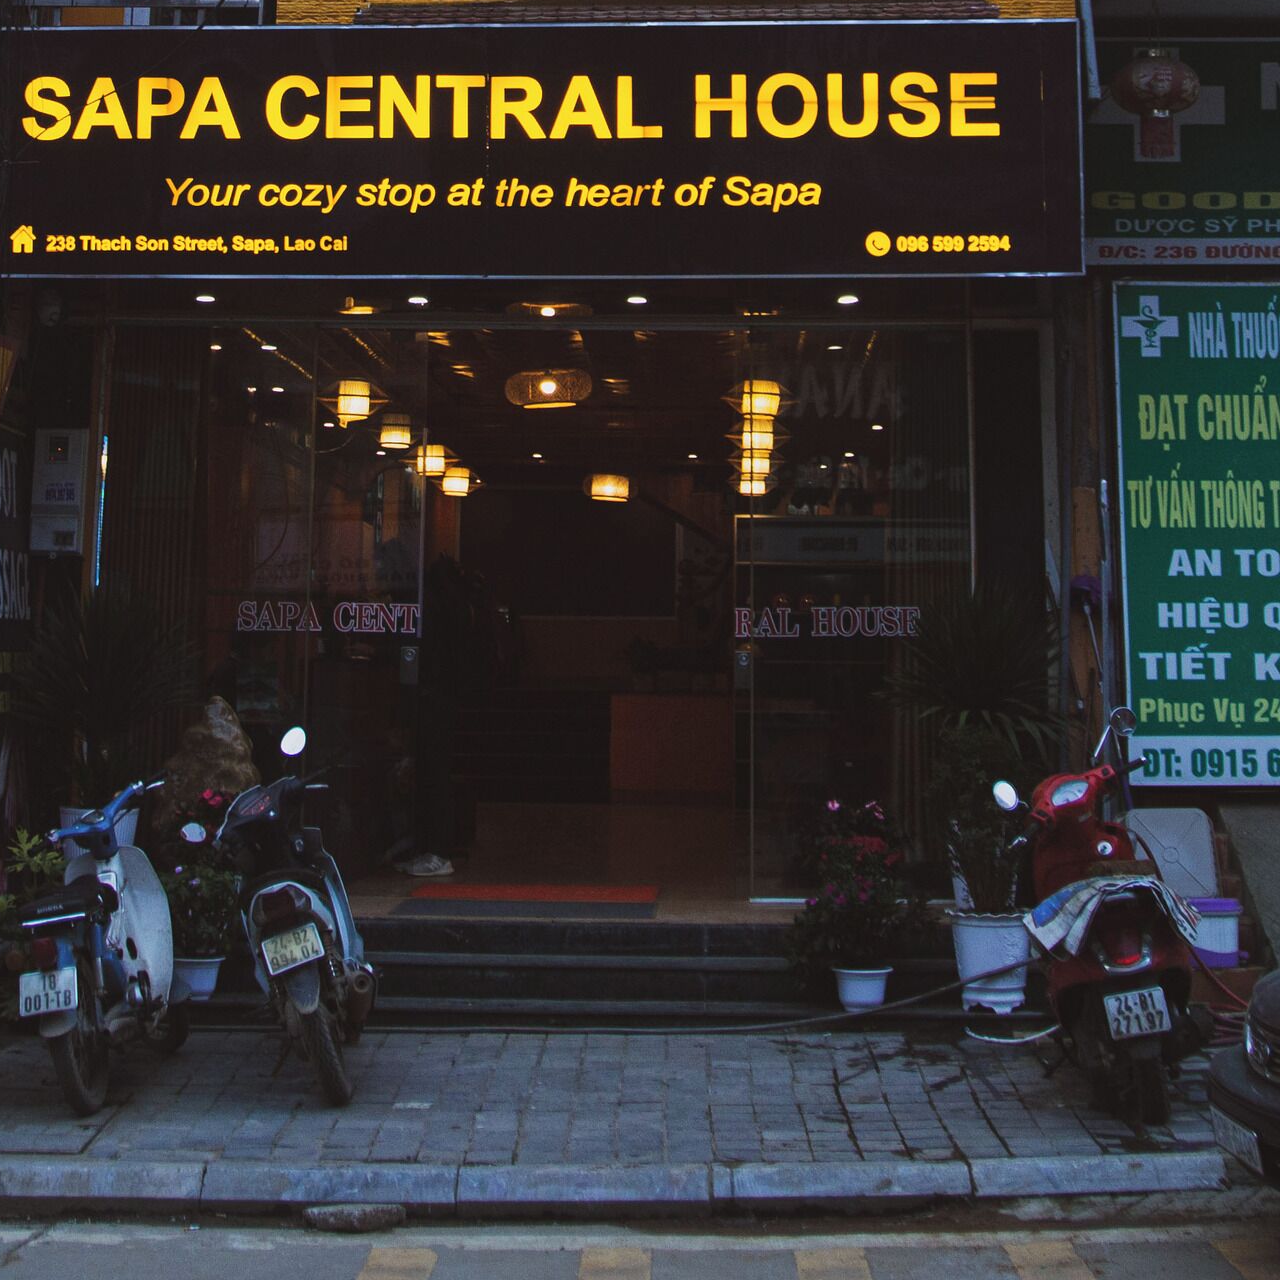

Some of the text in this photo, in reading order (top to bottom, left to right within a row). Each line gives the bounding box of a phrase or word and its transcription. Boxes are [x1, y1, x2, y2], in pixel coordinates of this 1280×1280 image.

[21, 71, 1001, 142] SAPA CENTRAL HOUSE
[165, 176, 823, 214] Your cozy stop at the heart of Sapa
[45, 234, 348, 255] 238 Thach Son Street, Sapa, Lao Cai
[896, 235, 1011, 253] 096 599 2594
[1153, 244, 1197, 259] 236
[1188, 300, 1227, 359] NHÀ
[1138, 394, 1189, 452] ĐẠT
[1157, 461, 1197, 529] VẤN
[1201, 470, 1266, 530] THÔNG
[1168, 548, 1223, 577] AN
[236, 601, 420, 634] SAPA CENT
[733, 606, 921, 638] RAL HOUSE
[1157, 596, 1250, 636] HIỆU
[1138, 642, 1233, 681] TIẾT
[1139, 697, 1205, 728] Phục
[1213, 697, 1245, 728] Vụ
[1142, 747, 1183, 778] ĐT:
[1191, 747, 1260, 779] 0915
